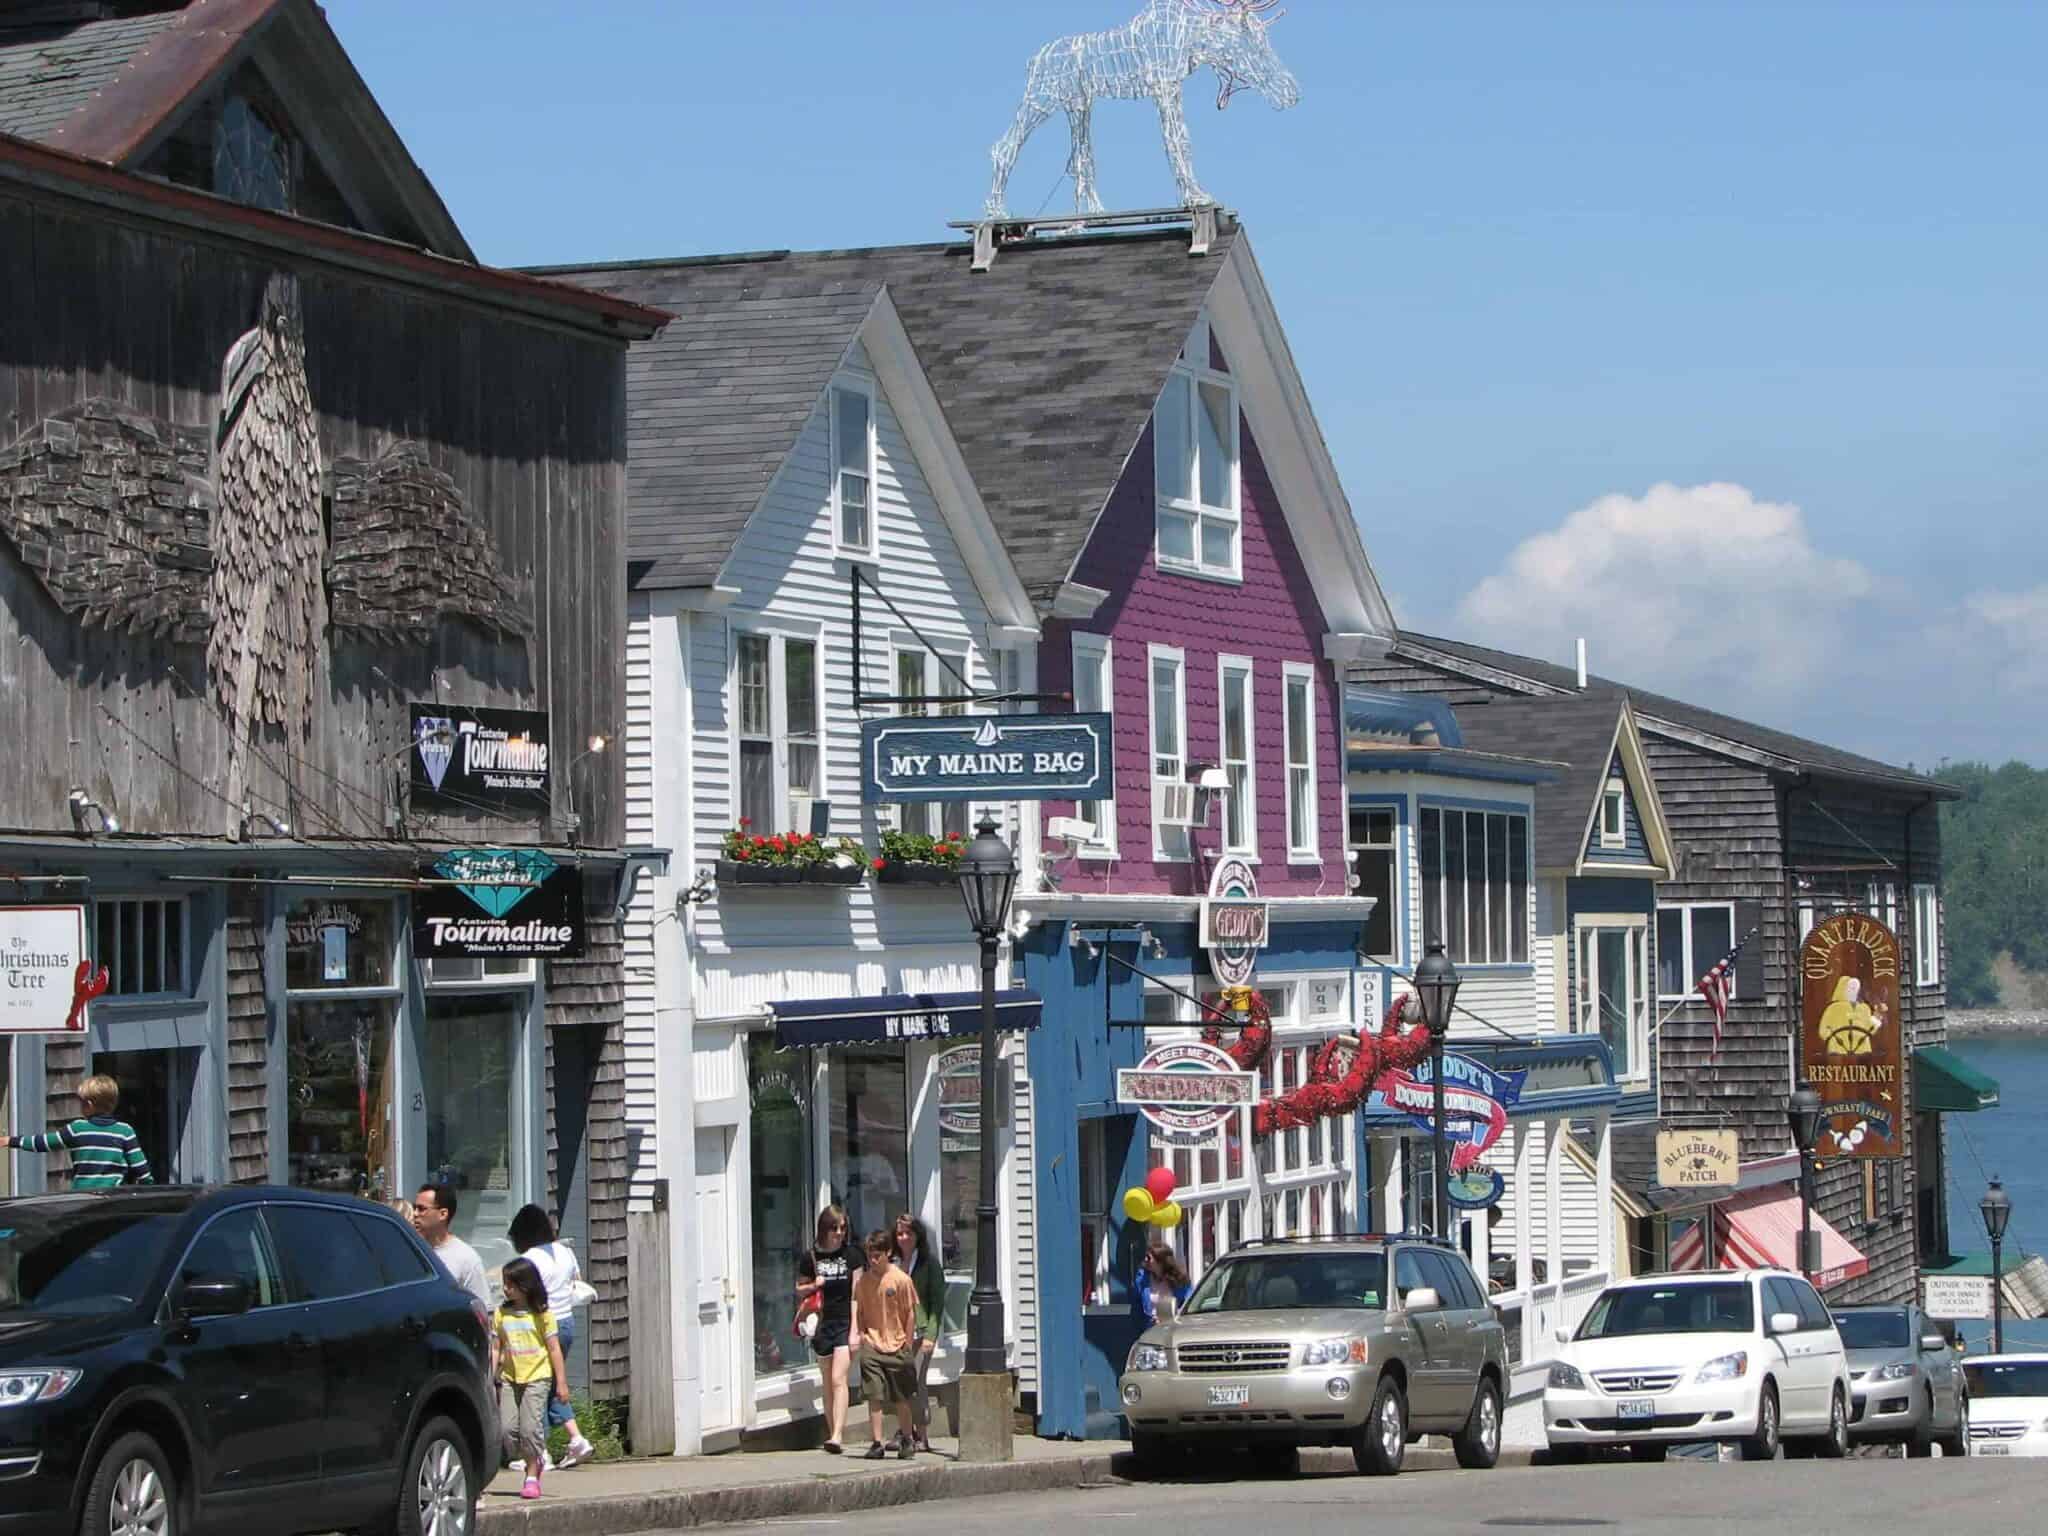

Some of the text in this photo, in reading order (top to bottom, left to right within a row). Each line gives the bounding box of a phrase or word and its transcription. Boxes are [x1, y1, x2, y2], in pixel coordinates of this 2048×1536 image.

[459, 721, 547, 776] Tourmaline
[890, 751, 1085, 776] MY MAINE BAG
[426, 917, 573, 946] Tourmaline
[456, 918, 508, 927] Featuring
[506, 943, 532, 951] State
[1806, 919, 1895, 979] QUARTERDECK
[0, 949, 70, 969] hristmas
[8, 969, 46, 989] Tree
[885, 1017, 900, 1037] MY
[902, 1015, 929, 1036] MAINE
[1155, 1047, 1185, 1064] MEET
[1187, 1047, 1204, 1058] ME
[1807, 1064, 1895, 1083] RESTAURANT
[1664, 1143, 1732, 1168] BLUEBERRY
[1679, 1170, 1717, 1182] PATCH
